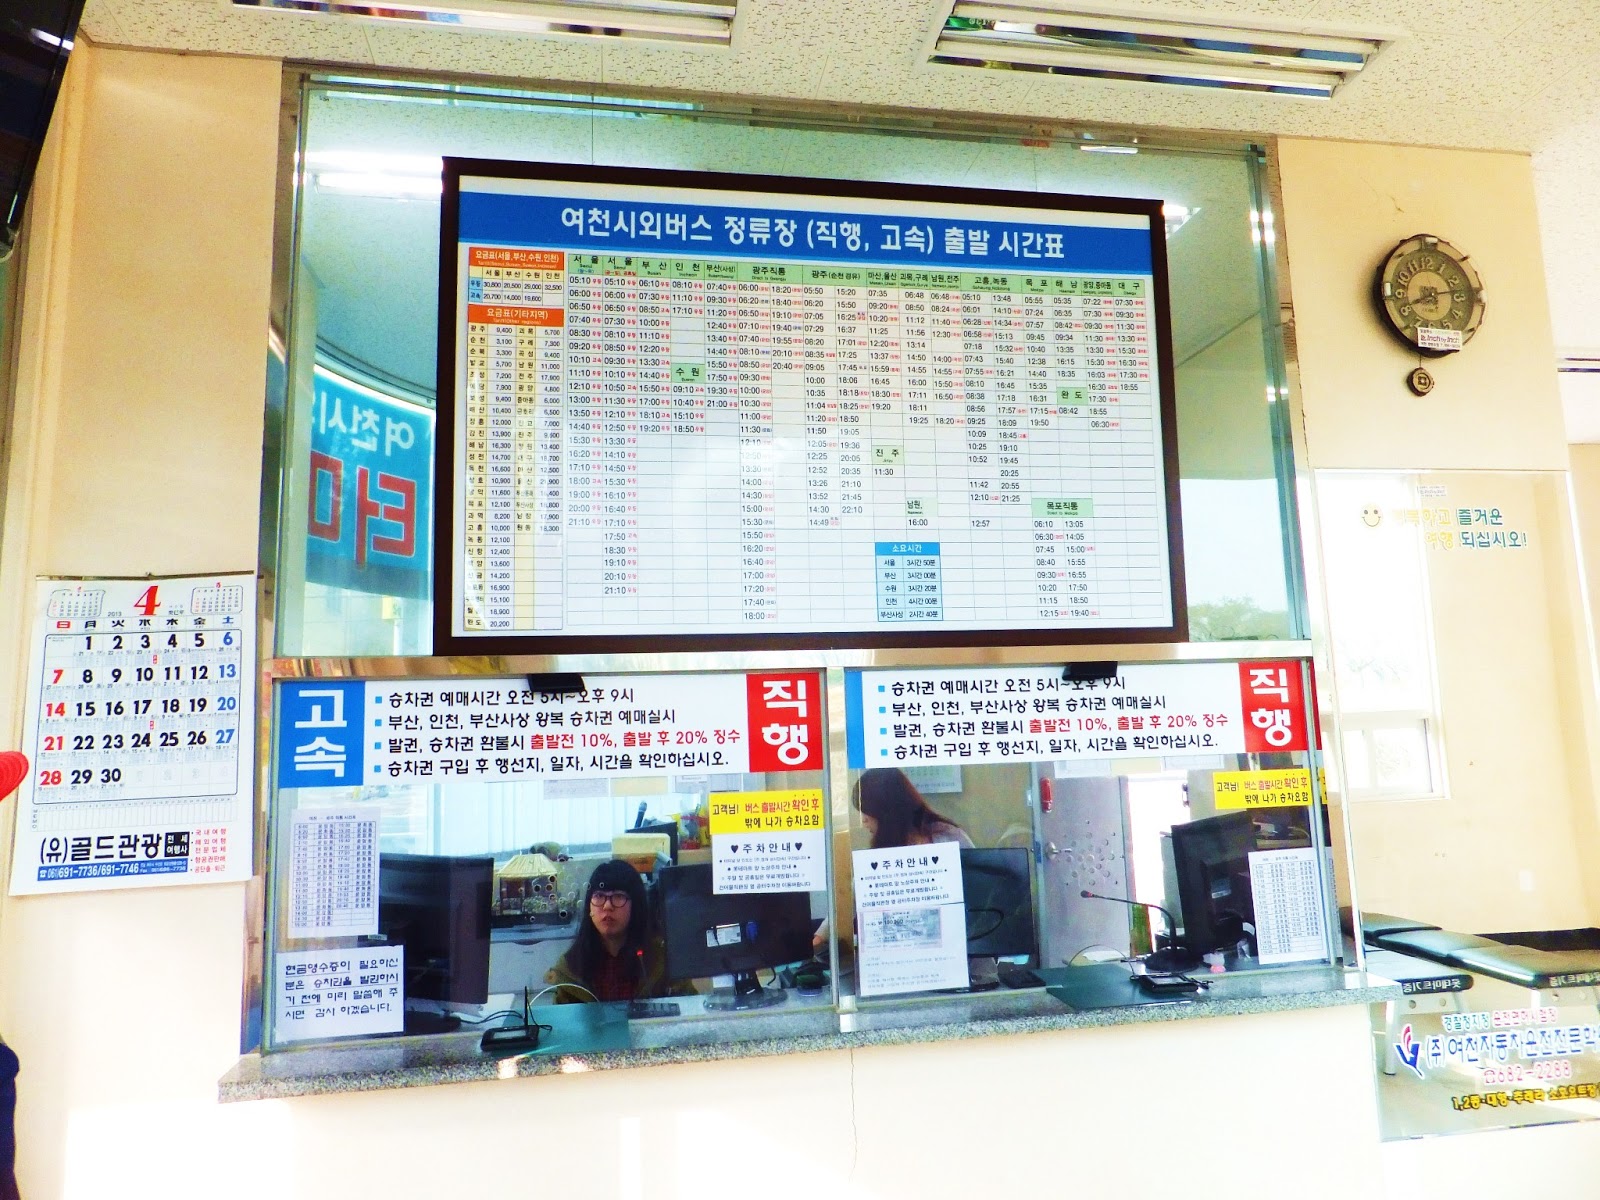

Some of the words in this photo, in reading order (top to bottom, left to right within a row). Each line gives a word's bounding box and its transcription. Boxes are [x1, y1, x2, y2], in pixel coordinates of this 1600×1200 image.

[561, 207, 713, 242] 여천시외버스
[724, 215, 798, 247] 정류장
[806, 220, 870, 253] (직행,
[880, 223, 934, 255] 고속)
[944, 227, 990, 256] 출발
[999, 231, 1065, 259] 시간표
[752, 266, 786, 276] 광주직통
[569, 275, 591, 285] 05:10
[672, 280, 693, 289] 08:10
[568, 289, 591, 298] 06:00
[771, 285, 792, 294] 18:20
[803, 287, 824, 295] 05:50
[992, 294, 1012, 303] 13:48
[1053, 297, 1072, 305] 05:35
[837, 326, 857, 334] 16:37
[1116, 322, 1135, 331] 11:30
[1058, 406, 1079, 415] 08:42
[673, 424, 696, 434] 18:50
[568, 462, 591, 472] 17:10
[873, 467, 894, 477] 11:30
[908, 518, 929, 527] 16:00
[1456, 508, 1504, 527] 즐거운
[1460, 531, 1528, 549] 되십시오!
[892, 544, 922, 553] 소요시간
[1066, 558, 1086, 567] 15:55
[604, 585, 627, 595] 21:10
[134, 585, 162, 616] 4
[56, 620, 71, 629] 日
[111, 619, 125, 628] 火
[222, 616, 234, 625] 土
[743, 611, 766, 620] 18:00
[85, 636, 92, 650] 1
[222, 631, 234, 645] 6
[52, 669, 64, 684] 7
[136, 667, 154, 682] 10
[218, 664, 237, 679] 13
[892, 681, 935, 697] 승차권
[940, 679, 999, 695] 예매시간
[1004, 678, 1031, 693] 오전
[1103, 676, 1126, 690] 9시
[389, 691, 434, 708] 승차권
[440, 690, 500, 707] 예매시간
[506, 690, 535, 706] 오전
[611, 688, 634, 704] 9시
[892, 702, 925, 717] 부산,
[931, 701, 964, 716] 인천,
[970, 700, 1027, 715] 부산사상
[1033, 698, 1060, 713] 왕복
[1066, 697, 1106, 712] 승차권
[1112, 695, 1166, 711] 예매실시
[76, 702, 96, 716] 15
[217, 697, 236, 711] 20
[1250, 668, 1293, 747] 직행
[388, 714, 423, 731] 부산,
[429, 713, 464, 730] 인천,
[470, 712, 530, 728] 부산사상
[535, 711, 564, 727] 왕복
[570, 710, 613, 726] 승차권
[618, 709, 676, 725] 예매실시
[761, 680, 809, 765] 직행
[893, 723, 927, 738] 발권,
[932, 721, 975, 737] 승차권
[981, 720, 1024, 735] 환불시
[1029, 718, 1071, 733] 출발전
[1077, 717, 1112, 732] 10%,
[1117, 715, 1144, 731] 출발
[1149, 715, 1162, 729] 후
[1167, 714, 1197, 729] 20%
[1202, 713, 1229, 728] 징수
[44, 736, 64, 751] 21
[215, 729, 235, 743] 27
[294, 689, 347, 777] 고속
[389, 737, 423, 753] 발권,
[429, 736, 474, 752] 승차권
[480, 735, 525, 751] 환불시
[530, 733, 575, 750] 출발전
[581, 732, 617, 749] 10%,
[623, 731, 653, 747] 출발
[657, 731, 670, 746] 후
[676, 730, 708, 745] 20%
[713, 729, 741, 745] 징수
[894, 744, 938, 760] 승차권
[944, 743, 972, 758] 구입
[978, 742, 991, 757] 후
[996, 740, 1044, 756] 행선지,
[1049, 738, 1081, 754] 일자,
[1087, 737, 1127, 752] 시간을
[1133, 734, 1218, 750] 확인하십시오.
[388, 760, 434, 777] 승차권
[440, 759, 469, 775] 구입
[475, 758, 489, 774] 후
[495, 757, 544, 775] 행선지,
[550, 756, 585, 772] 일자,
[590, 754, 633, 771] 시간을
[639, 751, 729, 769] 확인하십시오.
[39, 771, 62, 786] 28
[100, 768, 122, 783] 30
[712, 803, 739, 816] 고객님!
[745, 802, 760, 814] 버스
[761, 801, 791, 814] 출발시간
[792, 799, 809, 812] 확인
[811, 797, 820, 810] 후
[744, 817, 761, 829] 밖에
[765, 816, 782, 828] 나가
[786, 814, 820, 827] 승차요함
